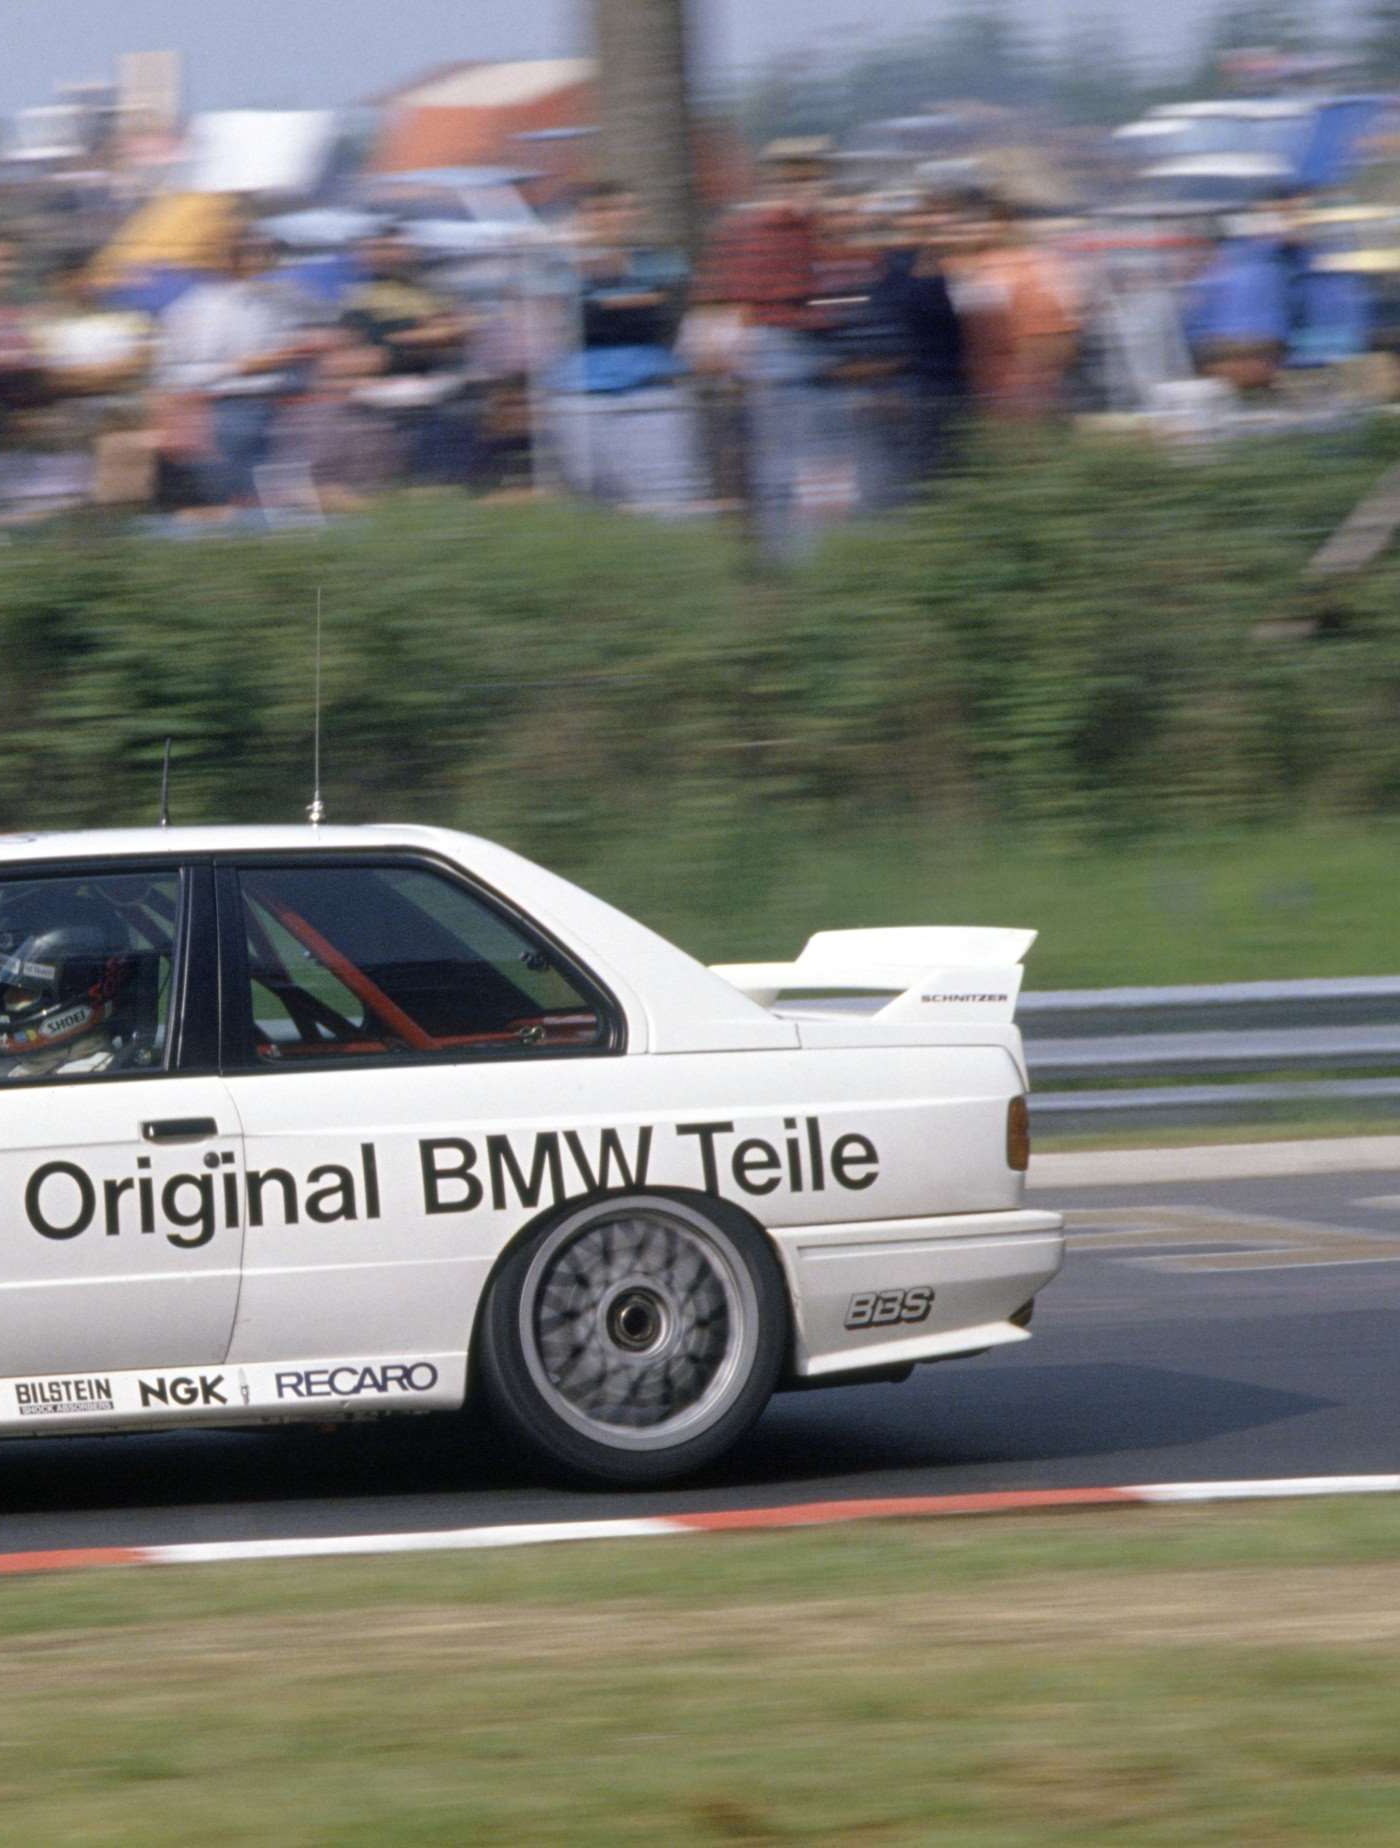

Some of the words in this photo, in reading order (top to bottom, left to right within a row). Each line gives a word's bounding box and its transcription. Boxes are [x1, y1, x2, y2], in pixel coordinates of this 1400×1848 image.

[920, 993, 1008, 1003] SCHNITZER
[46, 1009, 86, 1033] SHOEI
[24, 1142, 381, 1249] Original
[418, 1125, 654, 1215] BMW
[675, 1115, 880, 1198] Teile
[843, 1285, 935, 1330] BBS
[15, 1378, 113, 1404] BILSTEIN
[138, 1374, 229, 1408] NGK
[275, 1361, 438, 1398] RECARO
